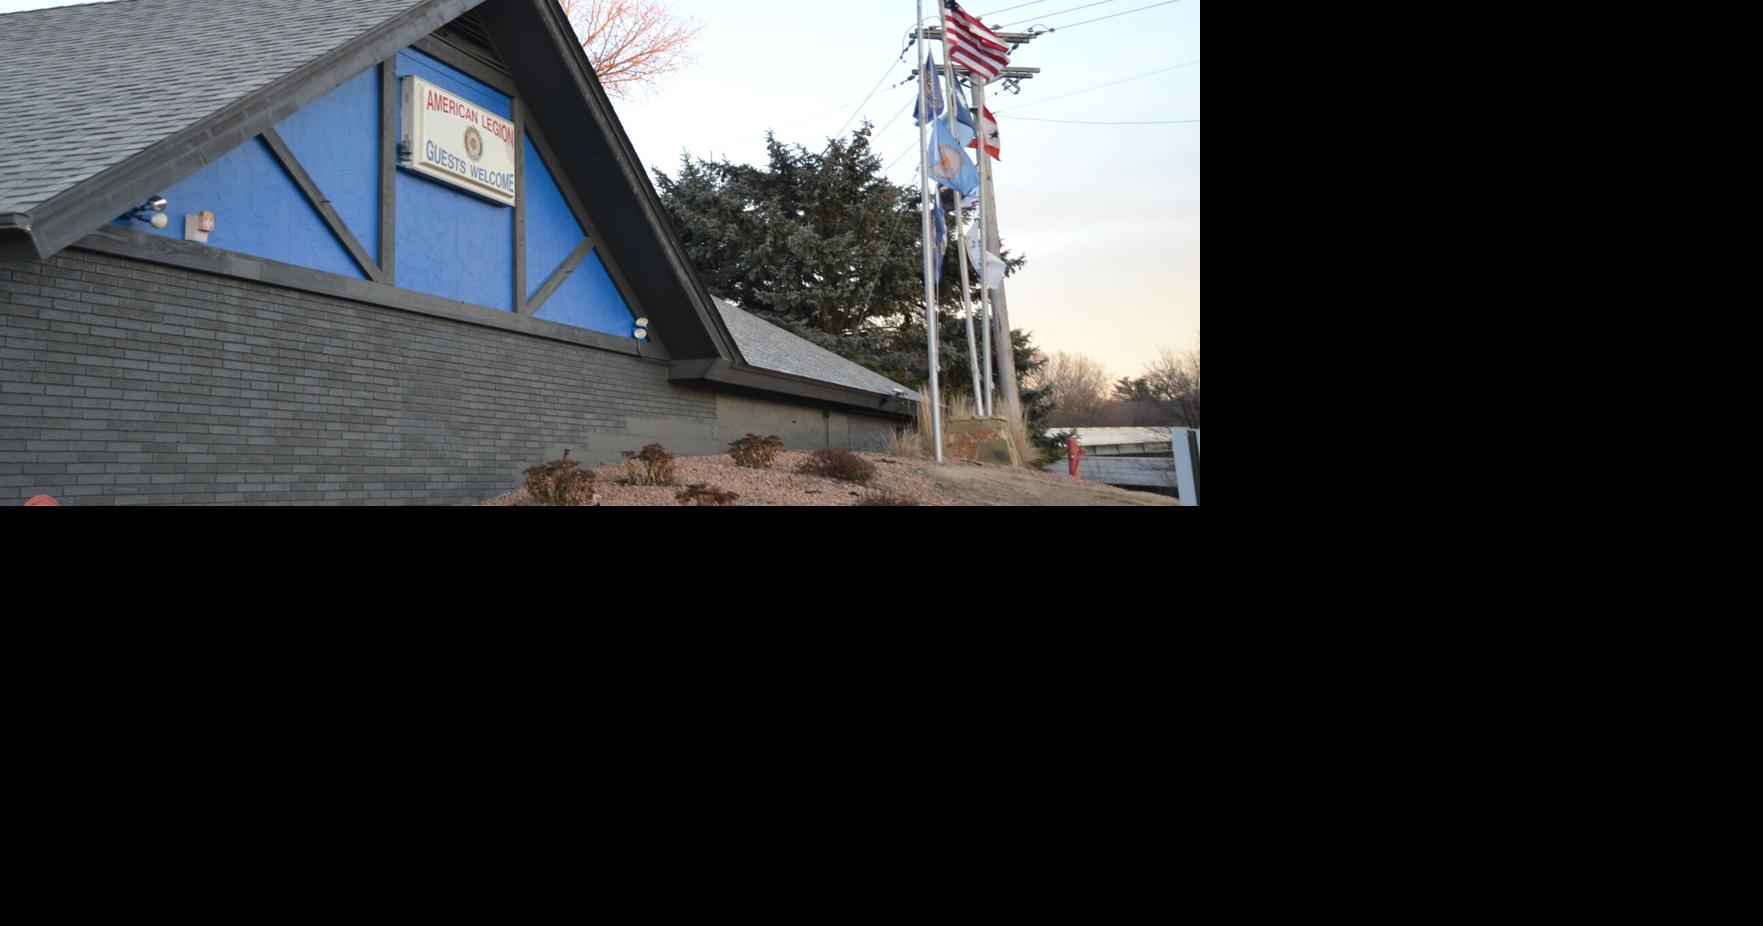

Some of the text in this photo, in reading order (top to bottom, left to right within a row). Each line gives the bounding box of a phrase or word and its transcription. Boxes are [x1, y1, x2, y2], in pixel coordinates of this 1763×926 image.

[427, 90, 478, 124] AMERICAN
[482, 114, 514, 148] LEGION
[426, 139, 466, 174] GUESTS
[471, 165, 514, 192] WELCOME
